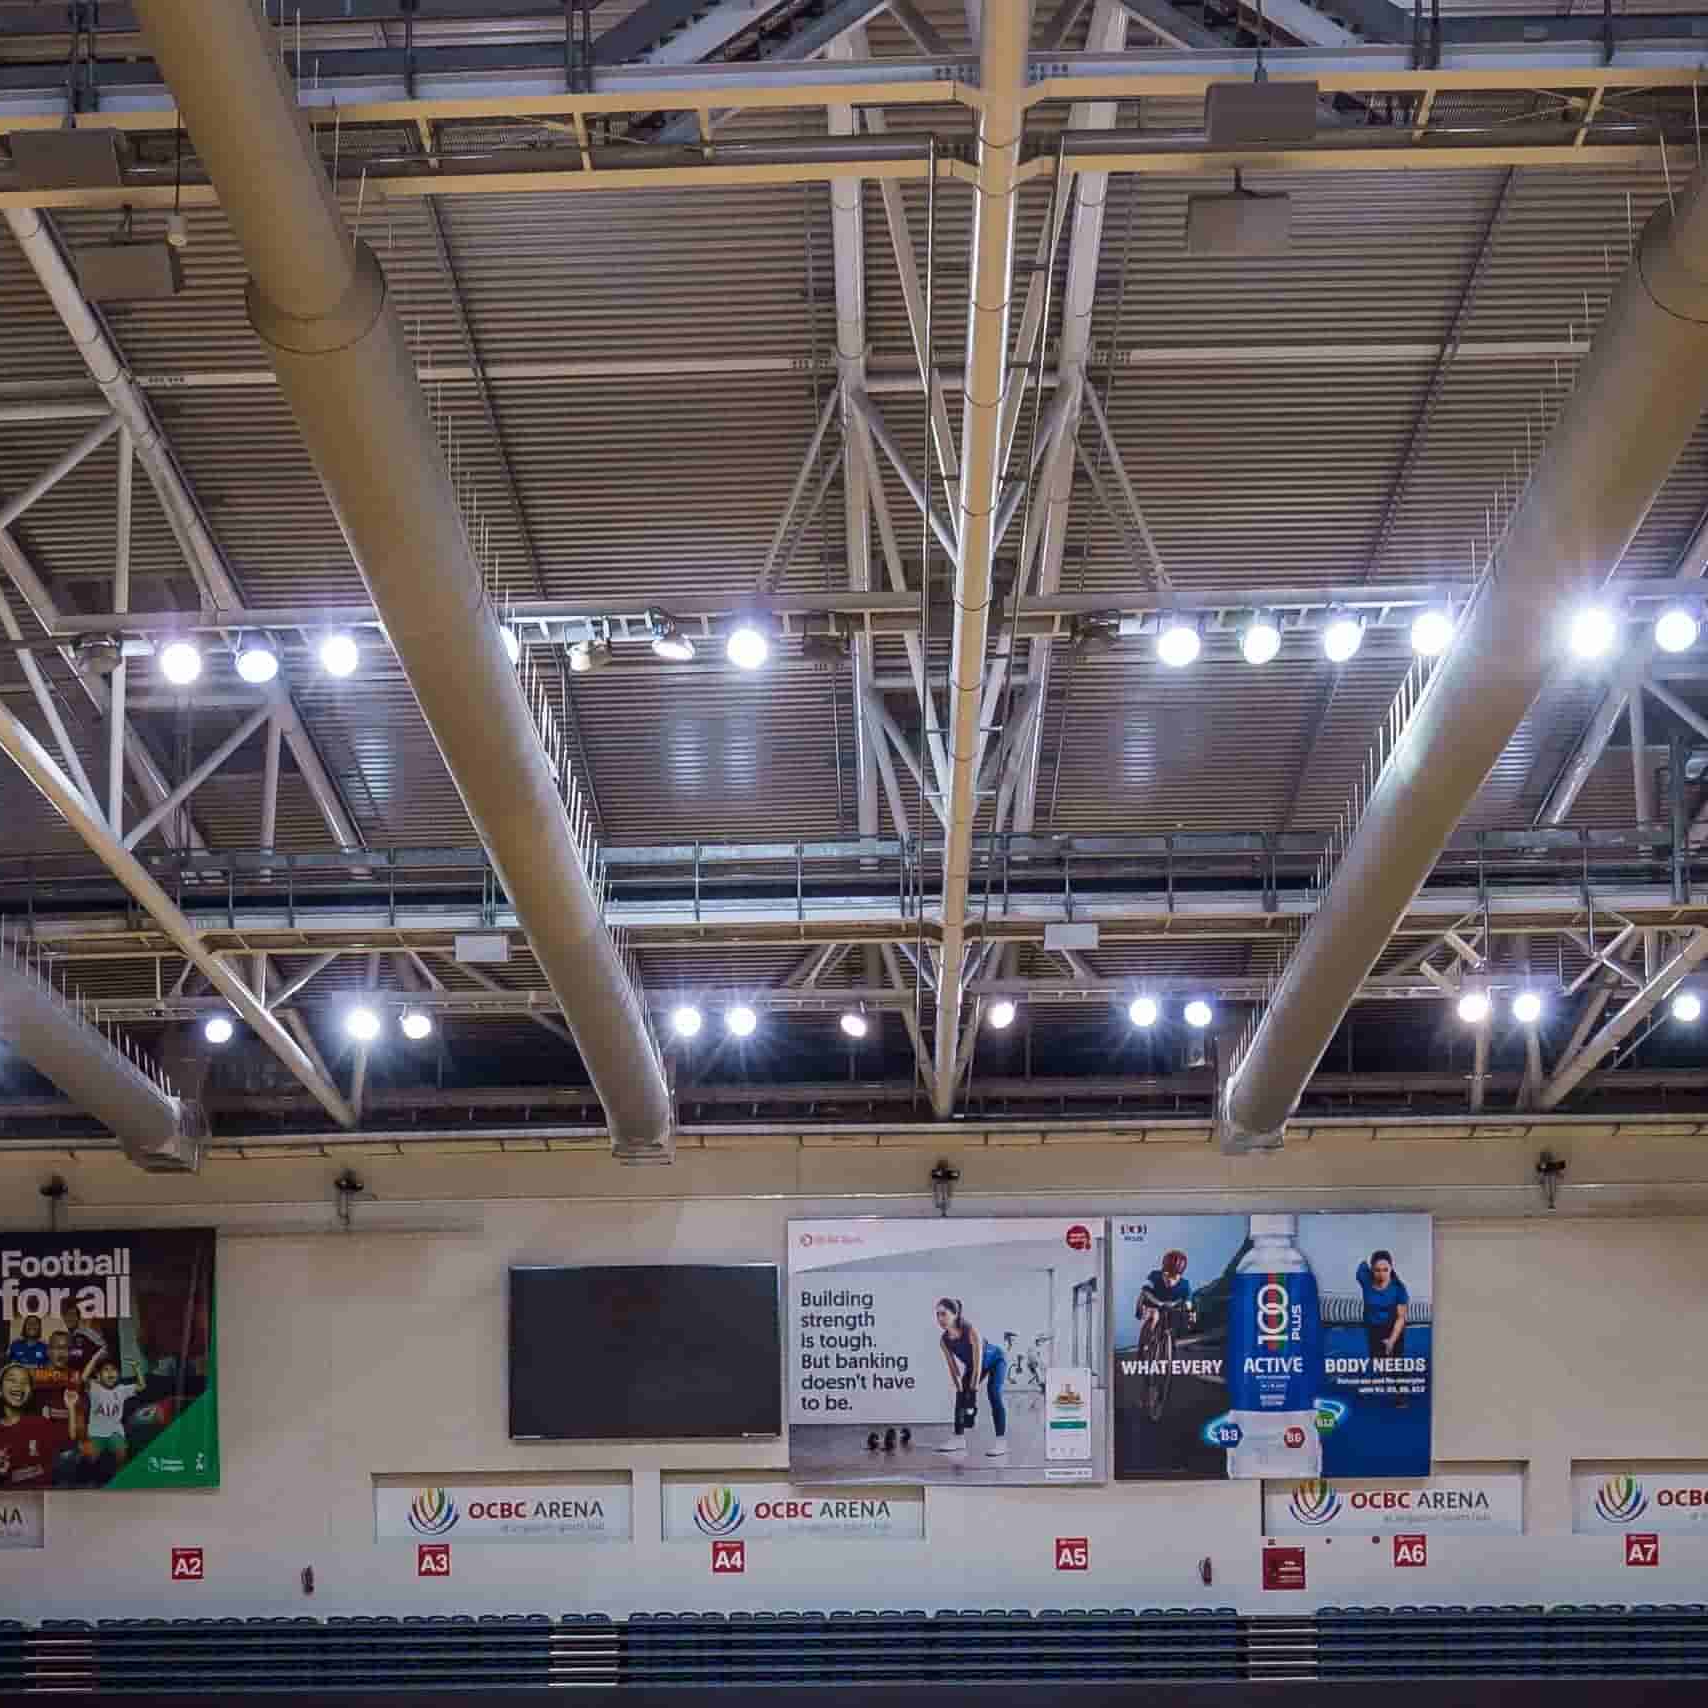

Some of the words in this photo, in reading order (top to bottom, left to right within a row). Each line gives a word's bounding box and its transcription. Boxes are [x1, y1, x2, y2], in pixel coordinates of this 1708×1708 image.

[1, 1247, 130, 1278] Football
[76, 1276, 130, 1319] all
[801, 1290, 874, 1309] Building
[801, 1311, 875, 1330] strength
[1257, 1283, 1289, 1346] 100
[1291, 1304, 1302, 1341] PLUS
[802, 1333, 814, 1348] is
[820, 1333, 877, 1351] tough.
[802, 1354, 831, 1369] But
[836, 1353, 909, 1371] banking
[1122, 1359, 1168, 1375] WHAT
[1172, 1359, 1223, 1375] EVERY
[1243, 1357, 1304, 1373] ACTIVE
[1325, 1358, 1371, 1373] BODY
[1373, 1357, 1426, 1372] NEEDS
[801, 1374, 868, 1390] doesn't
[873, 1374, 916, 1389] have
[802, 1396, 820, 1411] to
[826, 1395, 853, 1411] be.
[468, 1502, 527, 1519] OCBC
[533, 1501, 604, 1518] ARENA
[755, 1501, 813, 1519] OCBC
[820, 1501, 891, 1519] ARENA
[1350, 1492, 1410, 1510] OCBC
[1417, 1492, 1490, 1510] ARENA
[715, 1552, 742, 1569] A4
[1058, 1549, 1087, 1567] A5
[1396, 1546, 1425, 1564] A6
[1628, 1544, 1657, 1562] A7
[174, 1557, 203, 1576] A2
[420, 1554, 448, 1573] A3
